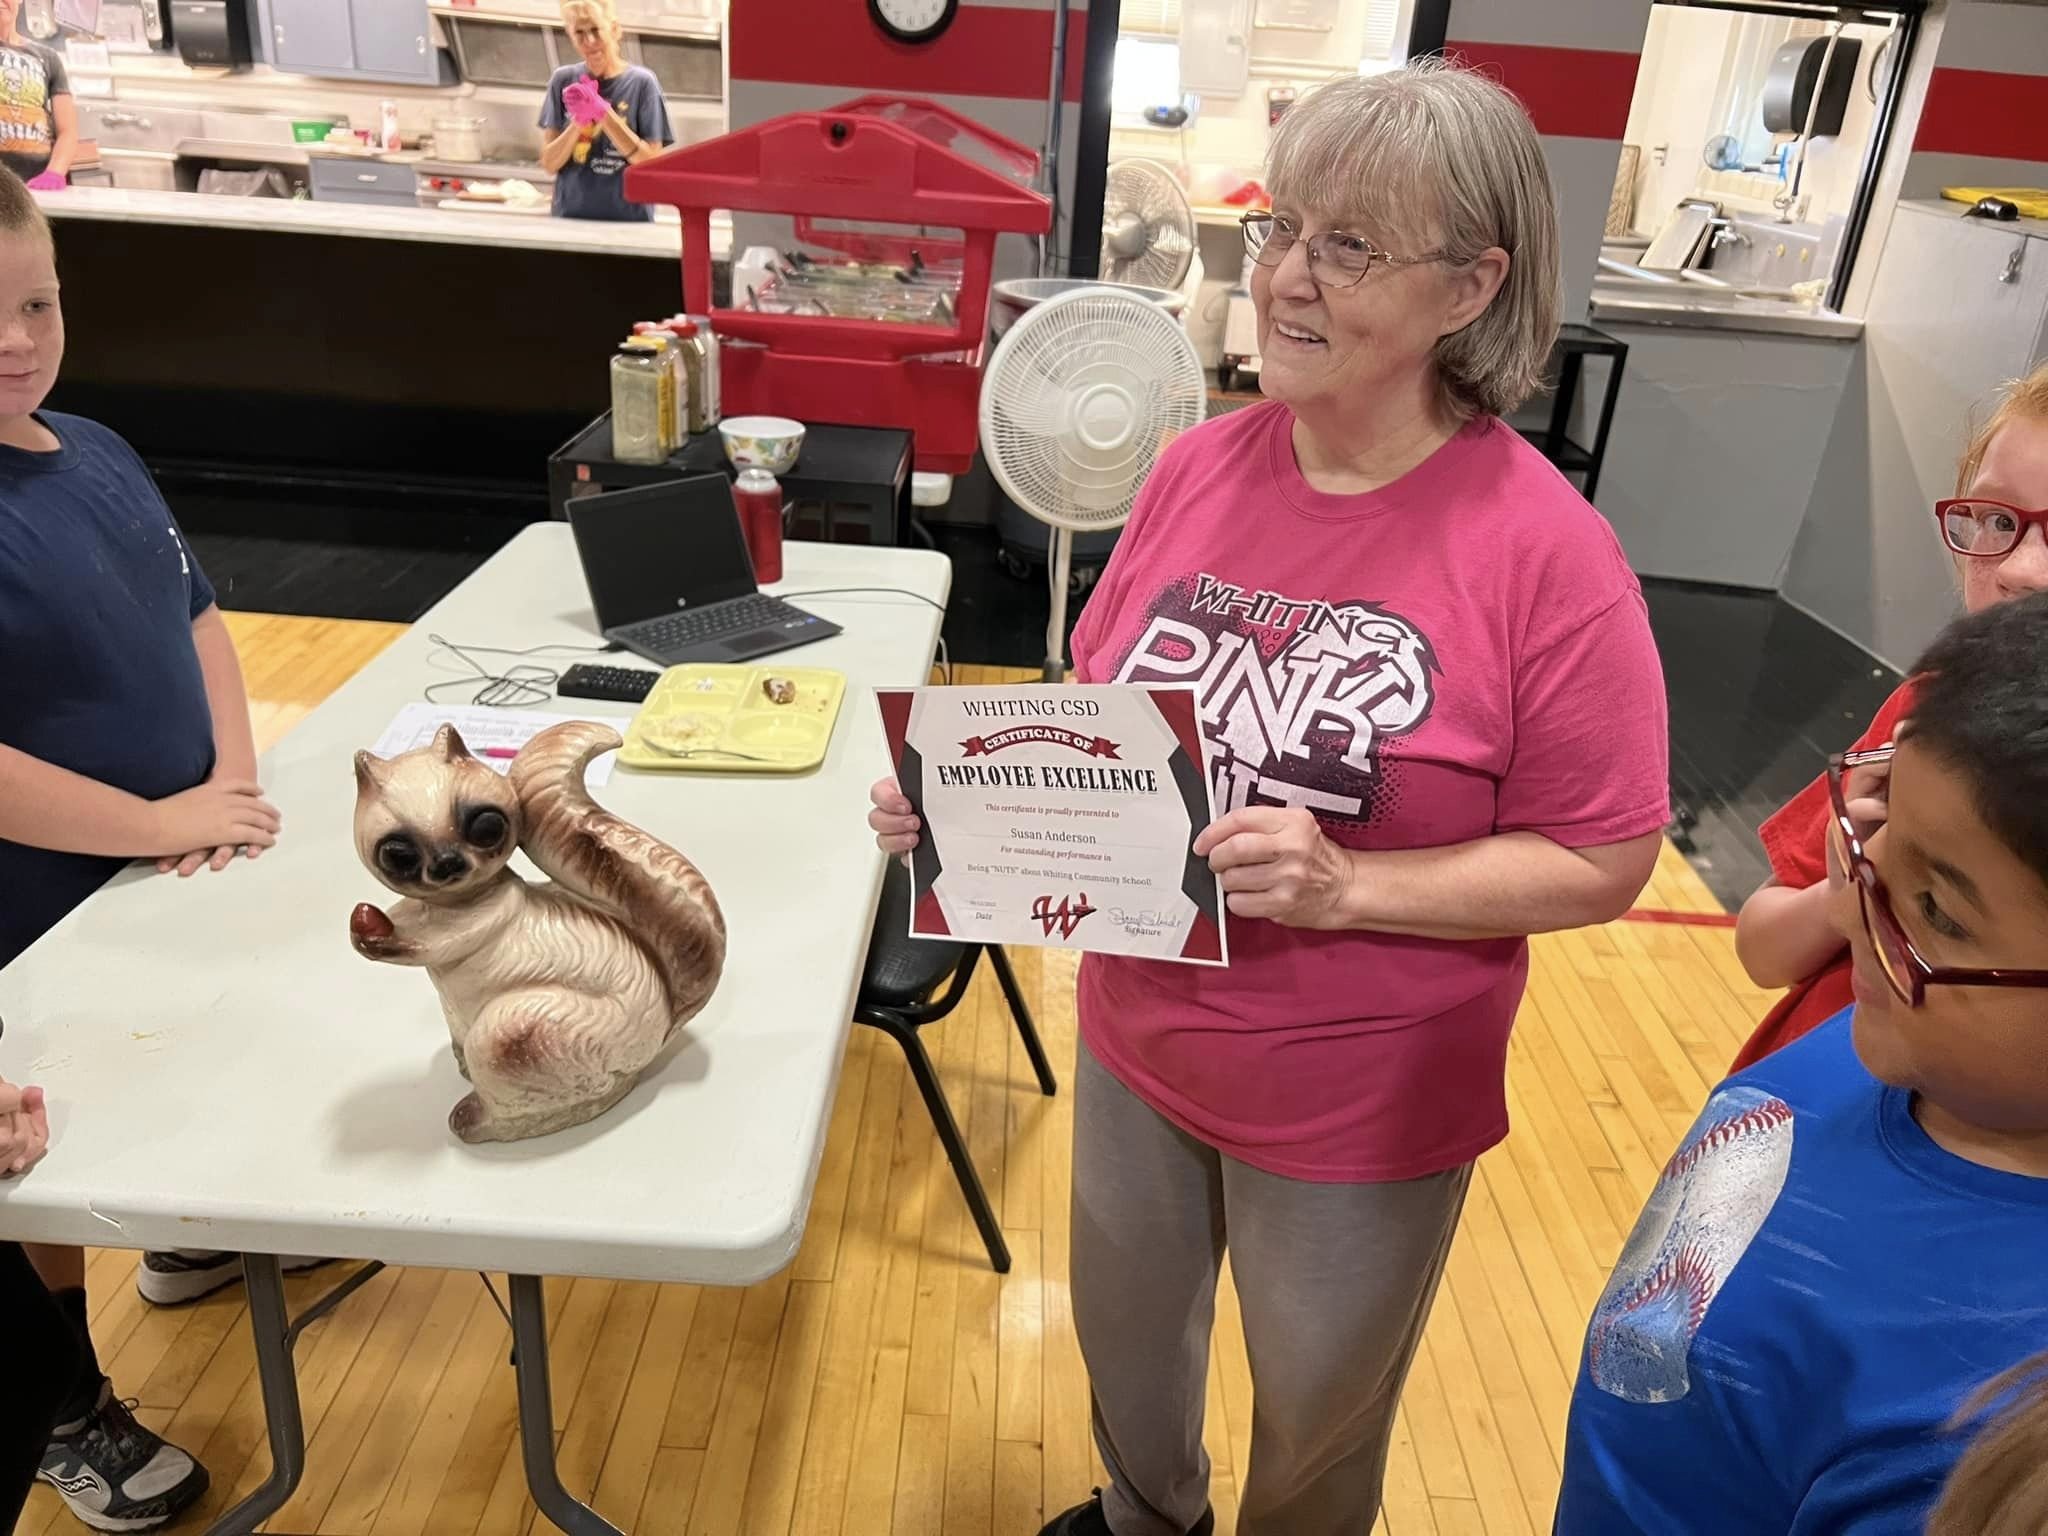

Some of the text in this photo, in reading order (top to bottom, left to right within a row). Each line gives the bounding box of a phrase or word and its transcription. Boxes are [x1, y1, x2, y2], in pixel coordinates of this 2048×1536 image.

[1189, 572, 1414, 654] WHITING
[1112, 614, 1407, 773] PINK
[962, 699, 1100, 717] WHITING CSD
[984, 728, 1094, 751] CERTIFICATE OF
[937, 765, 1158, 793] EMPLOYEE EXCELLENCE
[985, 803, 1000, 812] This
[1001, 804, 1036, 815] certificate
[1045, 807, 1073, 817] proudly
[1074, 808, 1110, 819] presented
[1111, 810, 1120, 819] to
[1010, 827, 1097, 845] Susan Anderson
[1000, 845, 1012, 853] For
[1014, 847, 1055, 859] outstanding
[1056, 849, 1102, 861] performance
[967, 863, 989, 874] Being
[1021, 866, 1041, 877] about
[1043, 869, 1073, 881] Whiting
[1074, 871, 1120, 885] Community
[975, 911, 993, 921] Date
[1124, 924, 1162, 937] Signature
